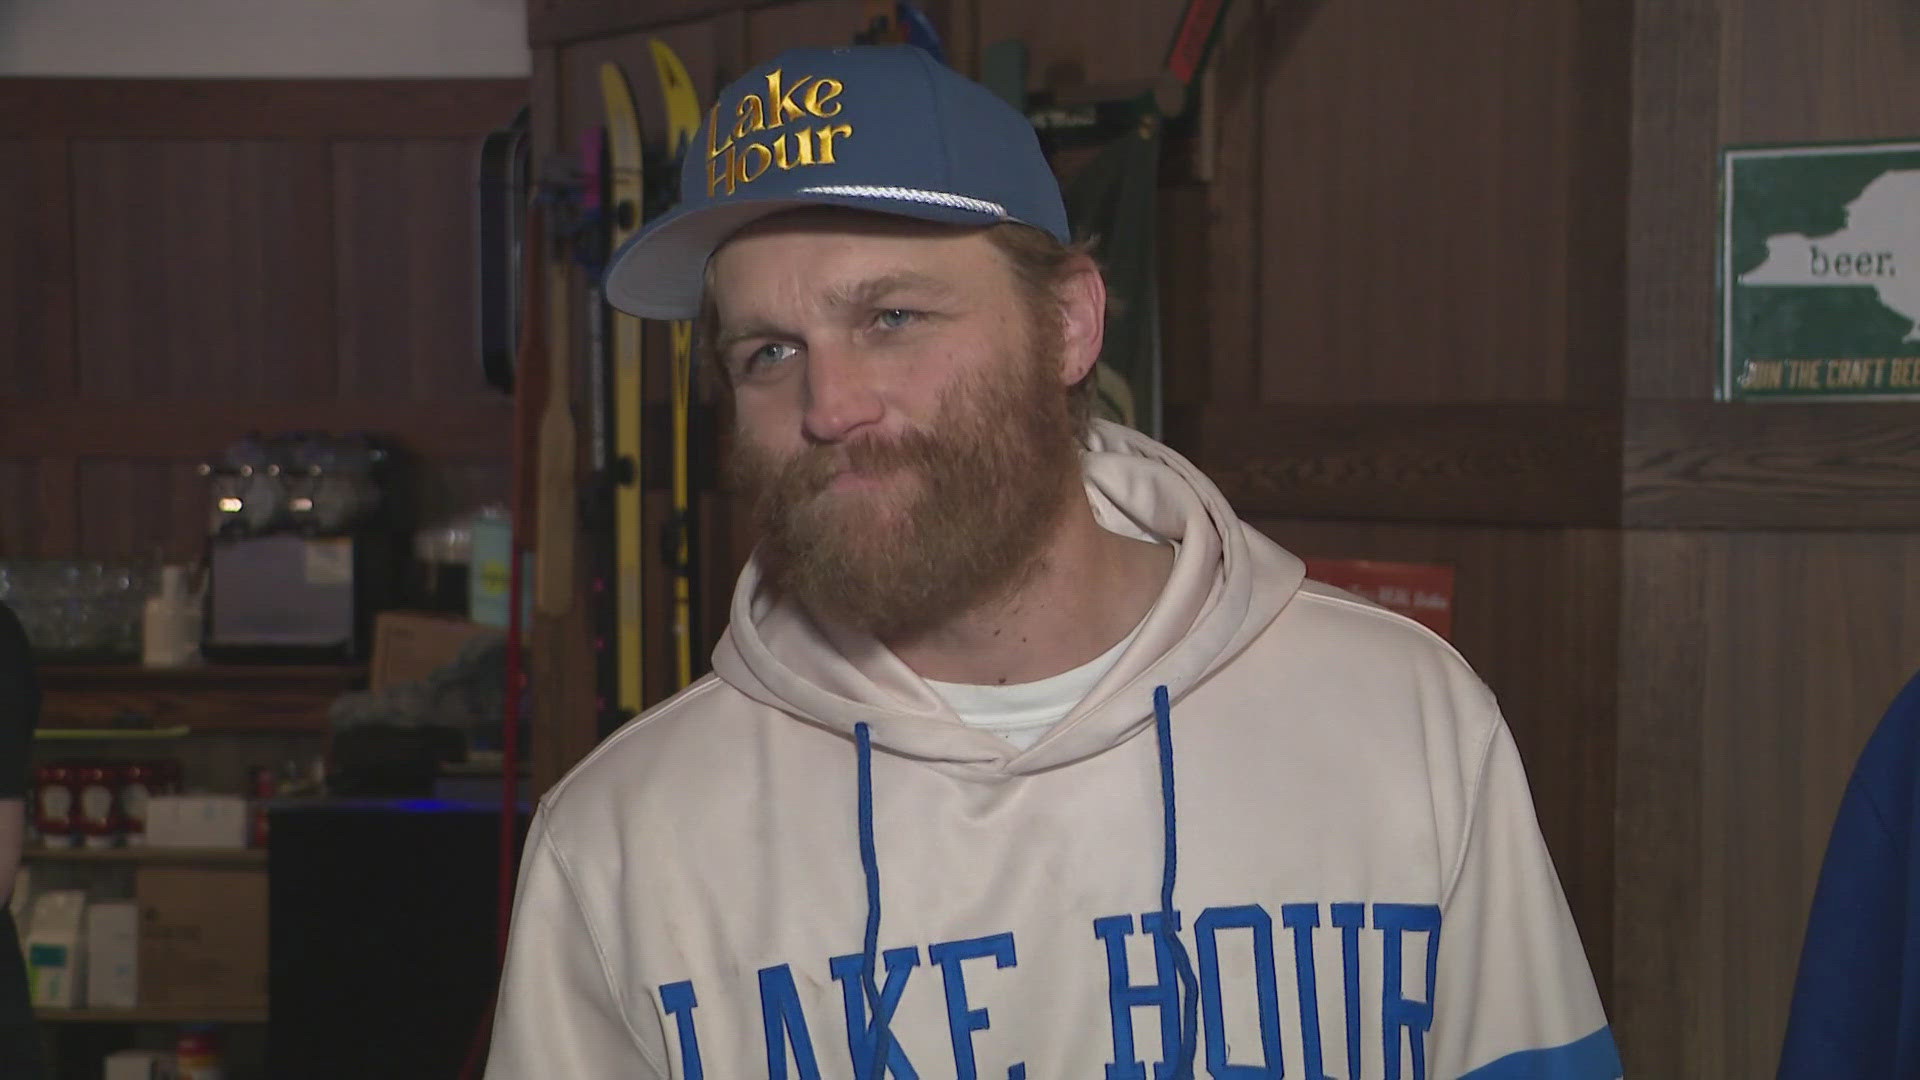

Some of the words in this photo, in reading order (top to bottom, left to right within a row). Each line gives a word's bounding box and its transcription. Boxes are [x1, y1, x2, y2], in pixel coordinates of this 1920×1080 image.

[706, 68, 844, 161] Lake
[706, 123, 854, 197] Hour
[1809, 246, 1897, 277] beer.
[1788, 359, 1820, 389] THE
[1826, 358, 1886, 388] CRAFT
[659, 931, 1028, 1080] LAKE
[1094, 902, 1443, 1080] HOUR
